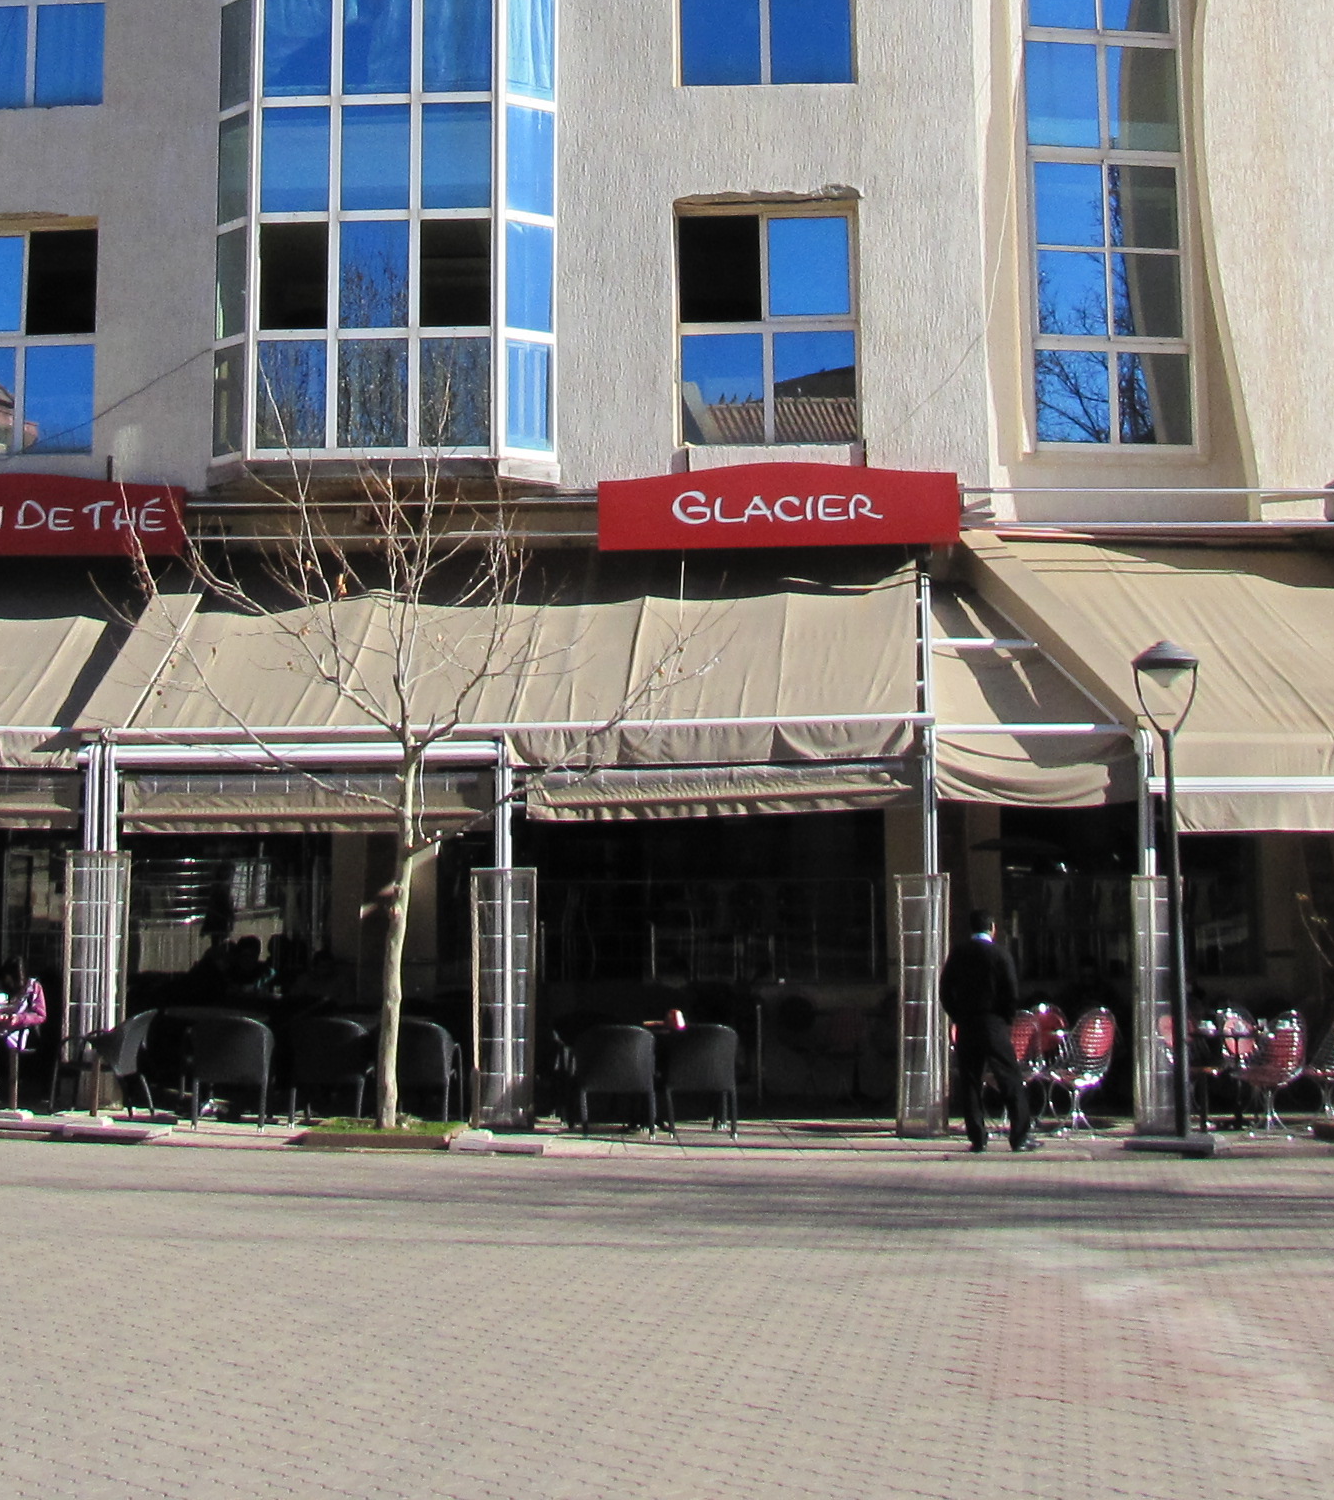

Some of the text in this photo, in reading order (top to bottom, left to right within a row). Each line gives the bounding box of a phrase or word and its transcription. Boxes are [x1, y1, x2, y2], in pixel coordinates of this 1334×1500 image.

[14, 500, 75, 531] DE
[82, 497, 167, 532] THÉ
[671, 490, 884, 525] GLACIER
